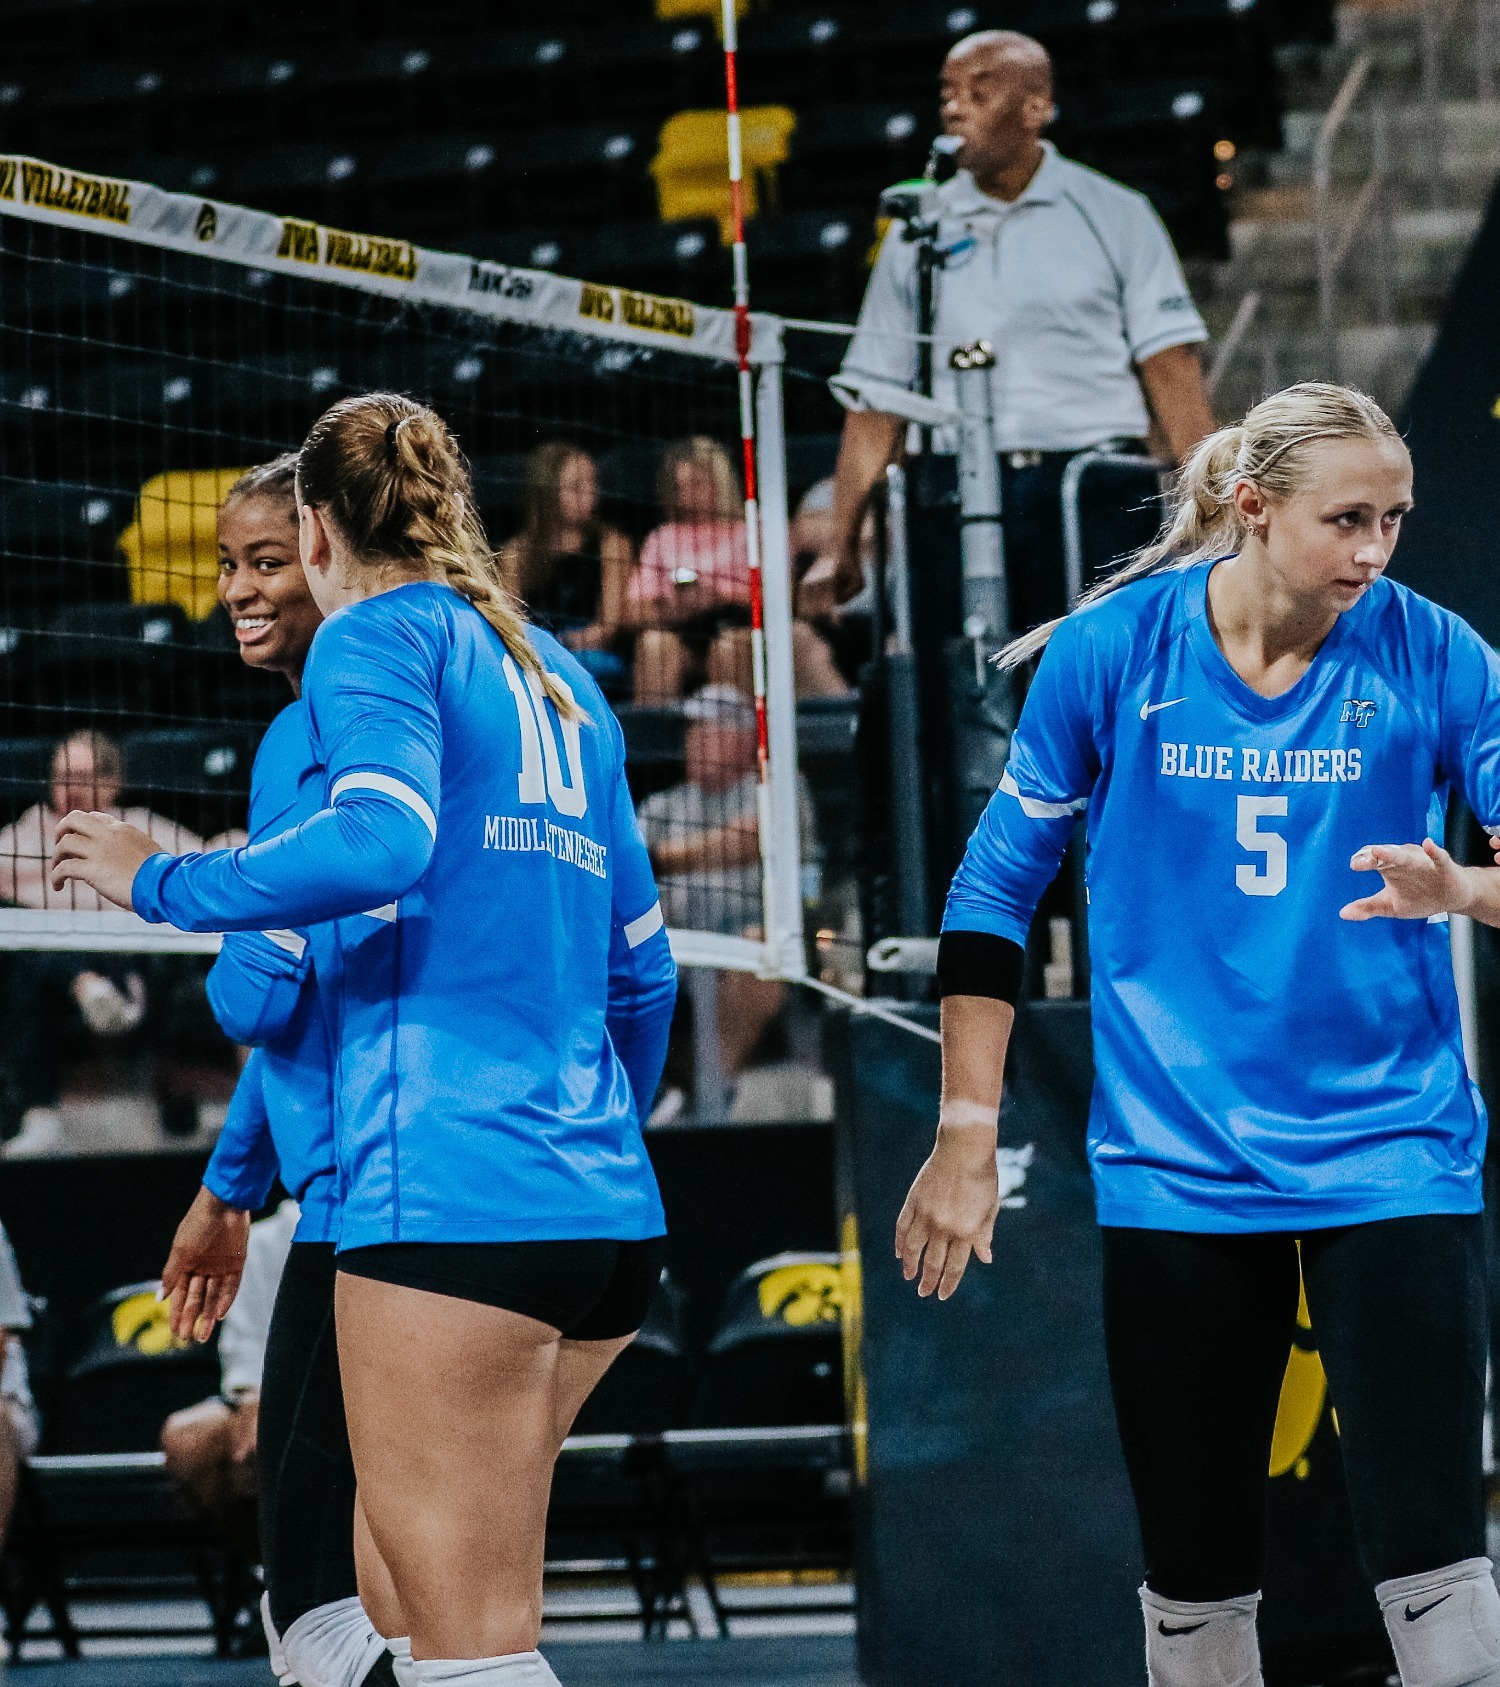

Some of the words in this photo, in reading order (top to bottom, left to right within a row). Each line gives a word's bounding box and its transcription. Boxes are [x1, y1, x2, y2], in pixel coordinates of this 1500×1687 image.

[502, 653, 588, 819] 10
[1160, 742, 1233, 781] BLUE
[1241, 748, 1362, 783] RAIDERS
[1235, 795, 1289, 897] 5
